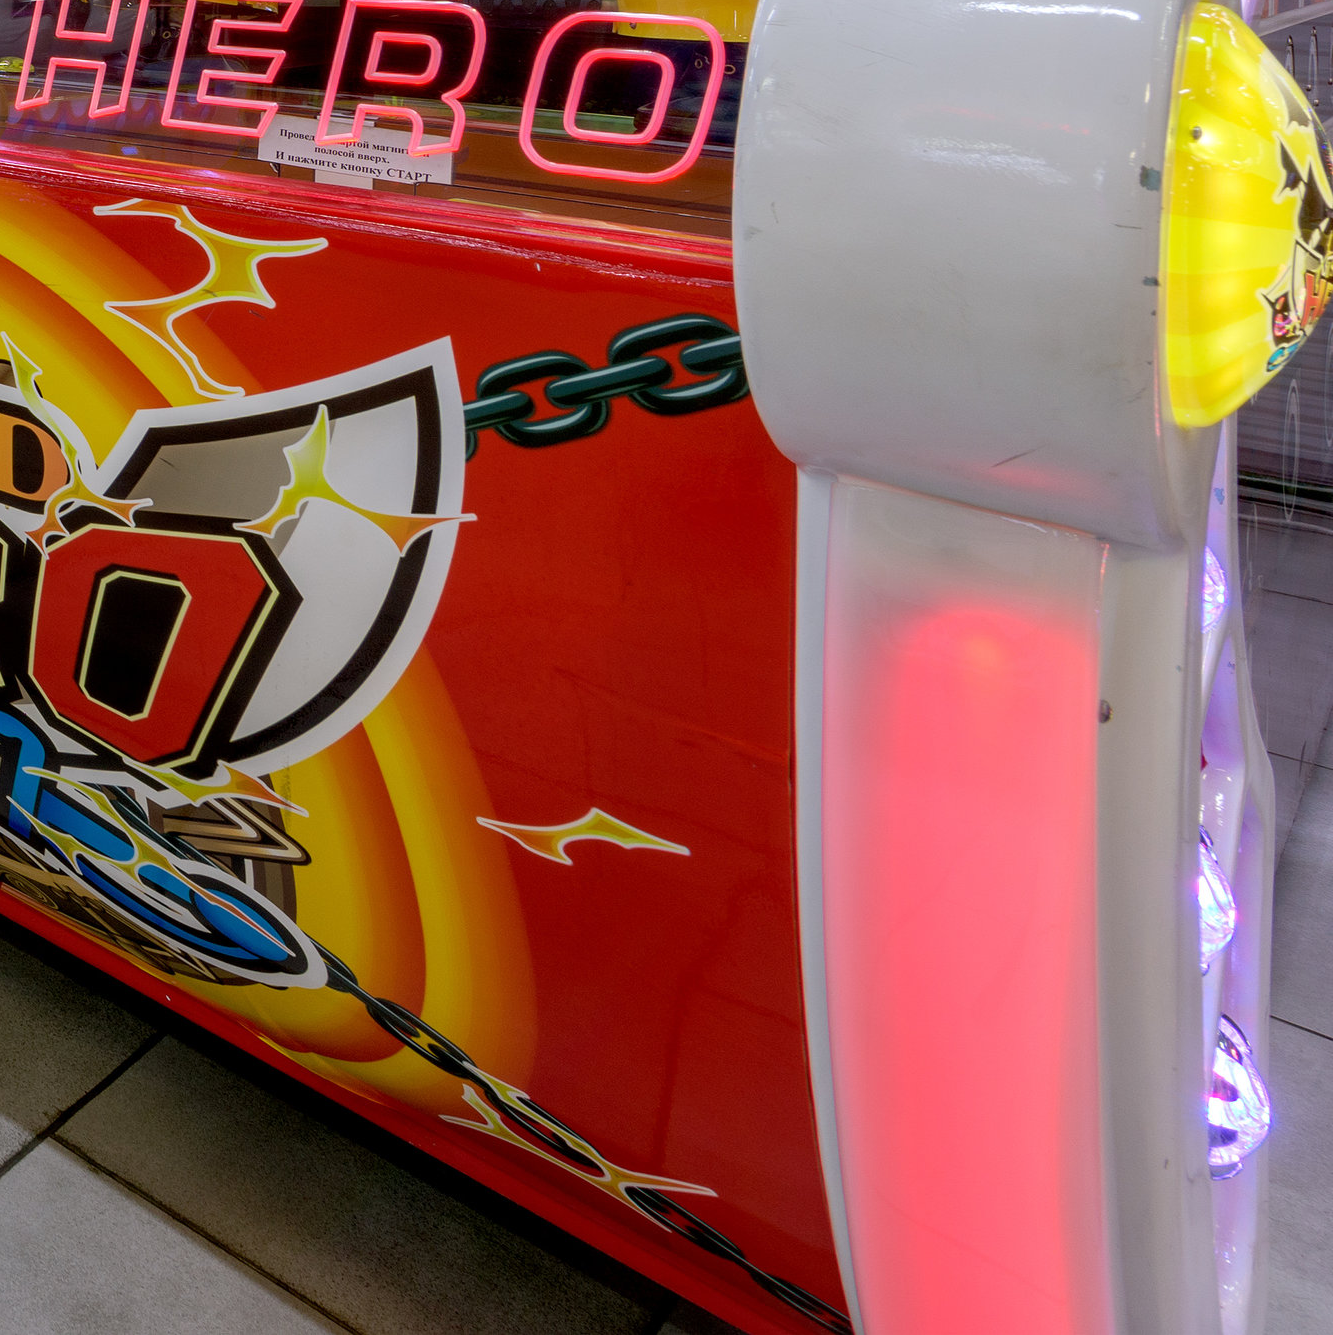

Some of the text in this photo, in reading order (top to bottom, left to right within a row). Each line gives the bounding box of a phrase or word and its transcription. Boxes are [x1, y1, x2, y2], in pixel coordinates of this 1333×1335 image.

[275, 150, 432, 183] И нажмите кнопку СТАРТ
[314, 146, 390, 164] полосой вверх.
